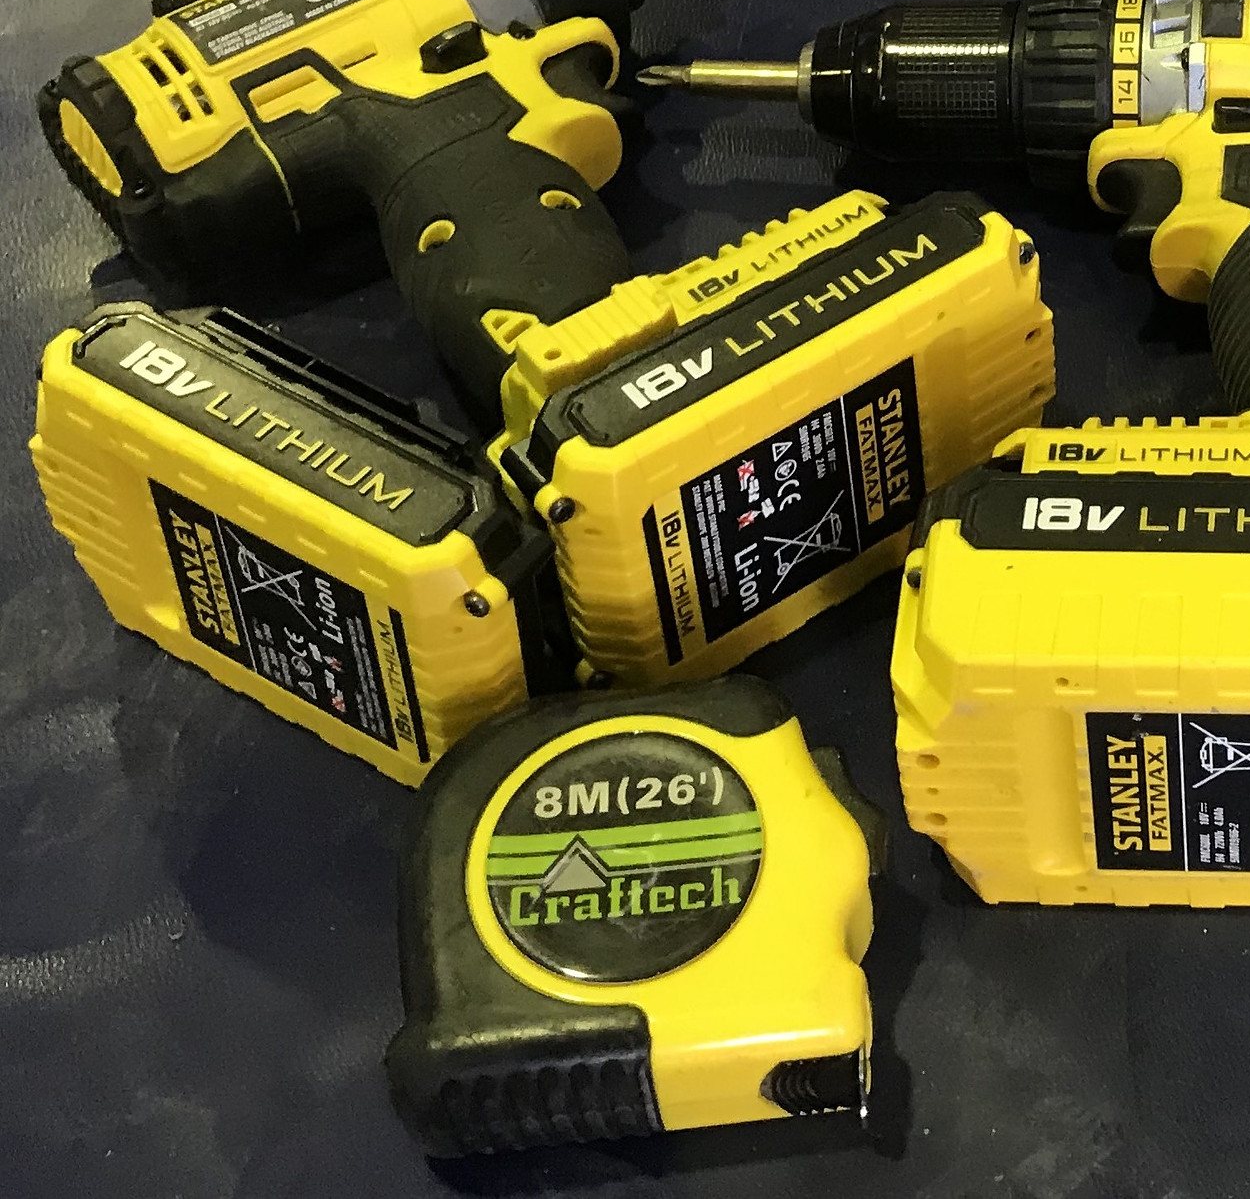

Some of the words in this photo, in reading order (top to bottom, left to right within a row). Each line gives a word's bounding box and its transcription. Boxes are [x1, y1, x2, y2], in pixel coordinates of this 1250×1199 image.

[1119, 31, 1136, 55] 16
[1118, 79, 1134, 104] 14
[752, 204, 871, 274] LITHIUM
[725, 234, 938, 358] LITHIUM
[204, 391, 415, 512] LITHIUM
[858, 418, 883, 514] FATMAX
[877, 387, 911, 507] STANLEY
[168, 508, 222, 632] STANLEY
[314, 577, 345, 645] Li-ion
[666, 553, 697, 638] LITHIUM
[734, 542, 761, 614] Li-ion
[376, 620, 405, 703] LITHIUM
[533, 766, 726, 819] 8M(26')
[1106, 734, 1143, 851] STANLEY
[508, 867, 742, 928] Craftech
